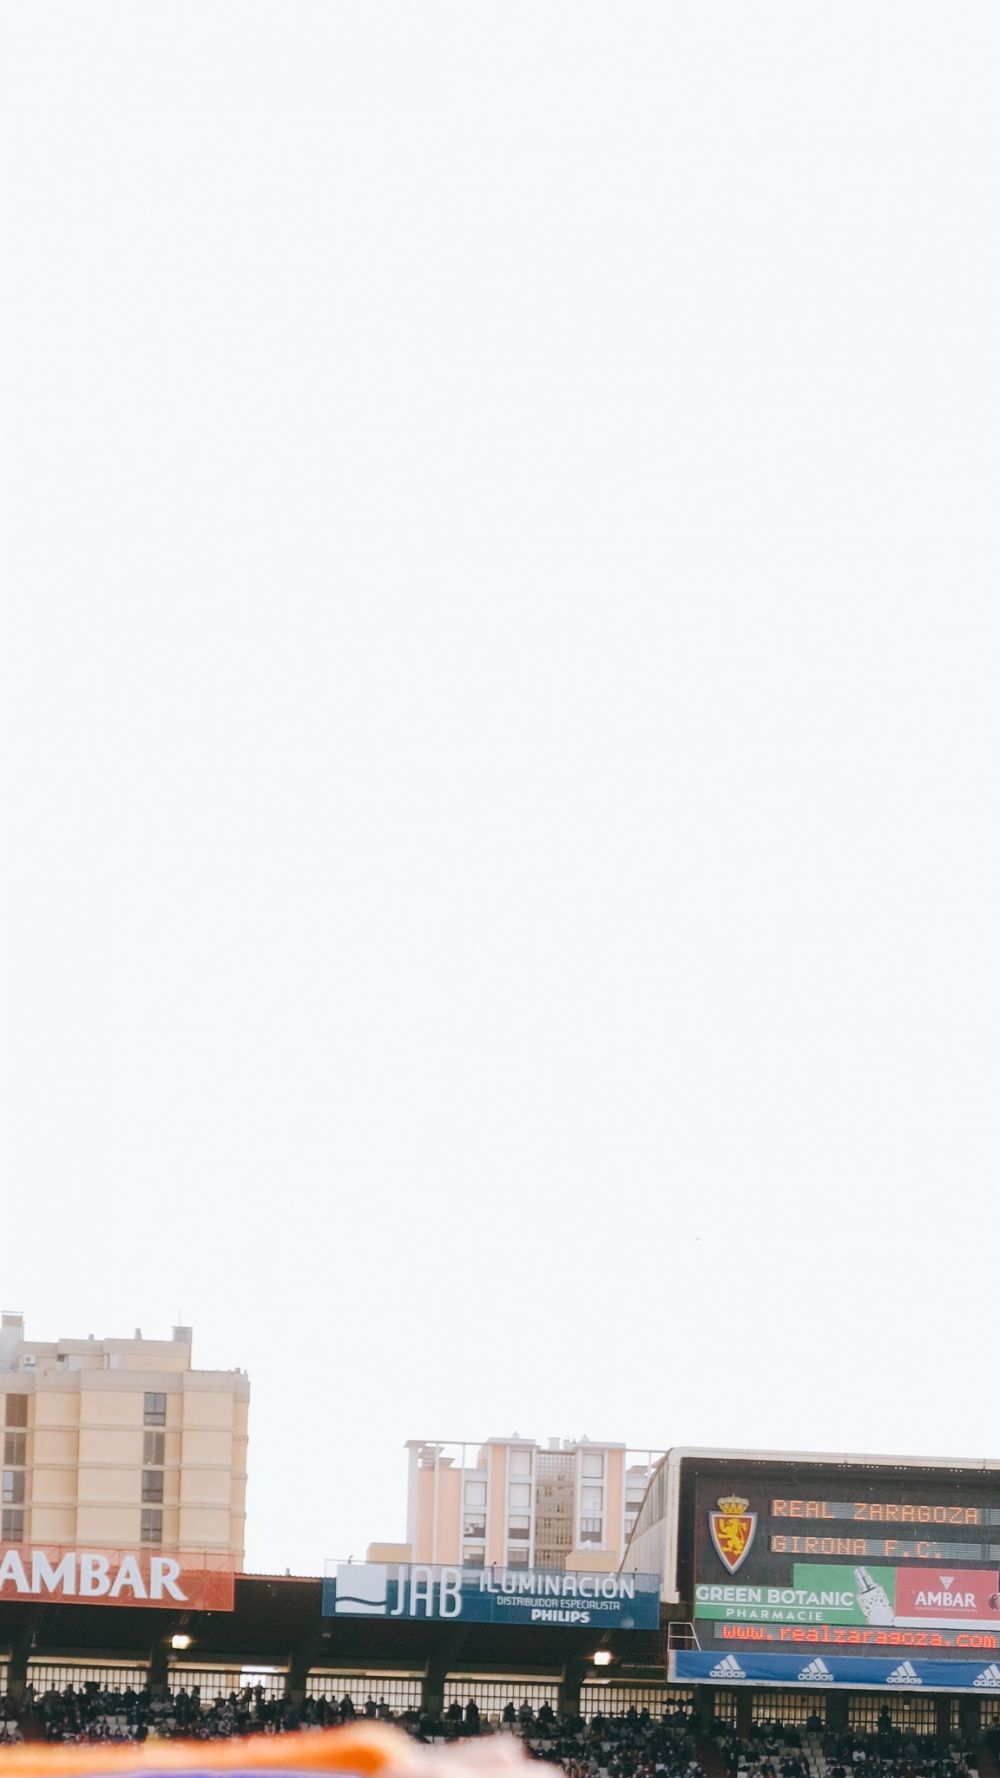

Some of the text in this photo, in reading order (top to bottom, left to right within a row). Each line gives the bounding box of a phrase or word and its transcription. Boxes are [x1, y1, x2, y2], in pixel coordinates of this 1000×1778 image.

[773, 1500, 835, 1519] REAL
[853, 1502, 979, 1525] ZARAGOZA
[772, 1535, 867, 1556] GIRONA
[0, 1549, 190, 1601] AMBAR
[390, 1565, 636, 1618] JAB ILUMINACIÓN
[695, 1586, 854, 1607] GREEN BOTANIC
[914, 1591, 977, 1608] AMBAR
[496, 1596, 620, 1610] DISTRIBUIDOR ESPECIALISTA
[531, 1610, 591, 1623] PHILIPS
[725, 1608, 824, 1621] PHARMACIE
[721, 1624, 997, 1648] www.realzaragoza.com
[709, 1669, 746, 1679] adidas
[797, 1672, 834, 1682] adidas
[886, 1675, 923, 1685] adidas
